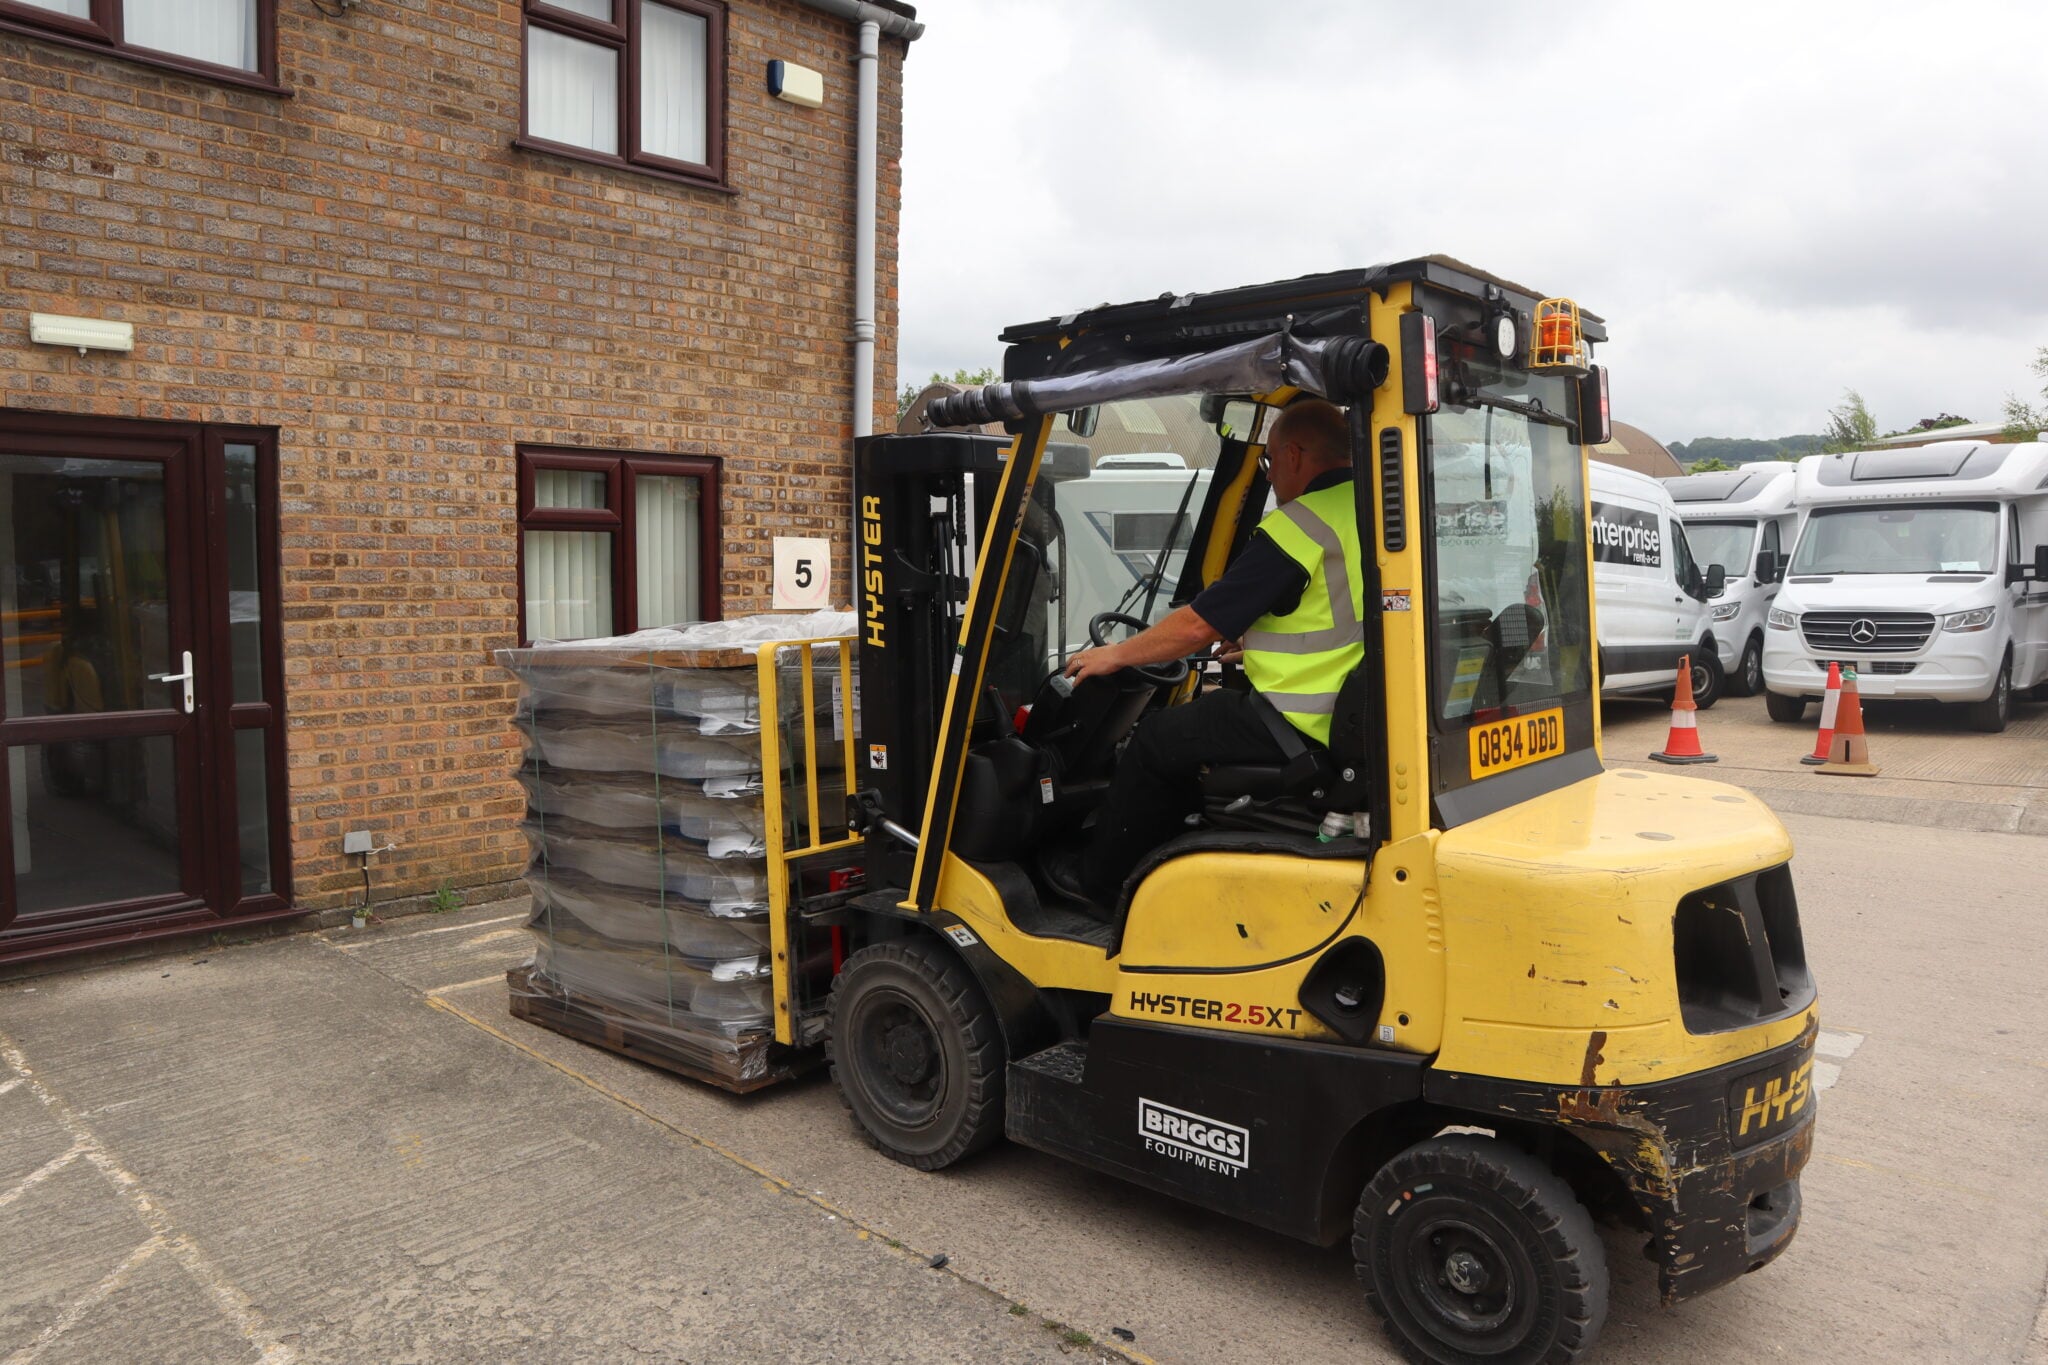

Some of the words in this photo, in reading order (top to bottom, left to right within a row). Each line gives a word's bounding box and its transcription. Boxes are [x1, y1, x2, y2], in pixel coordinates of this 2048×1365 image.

[795, 559, 812, 588] 5
[863, 495, 885, 648] HYSTER
[1633, 552, 1660, 565] rent-a-car
[1478, 722, 1523, 767] Q834
[1527, 715, 1558, 756] DBD
[1739, 1058, 1813, 1135] HYS
[1146, 1108, 1241, 1157] BRIGGS
[1146, 1138, 1241, 1179] EQUIPMENT
